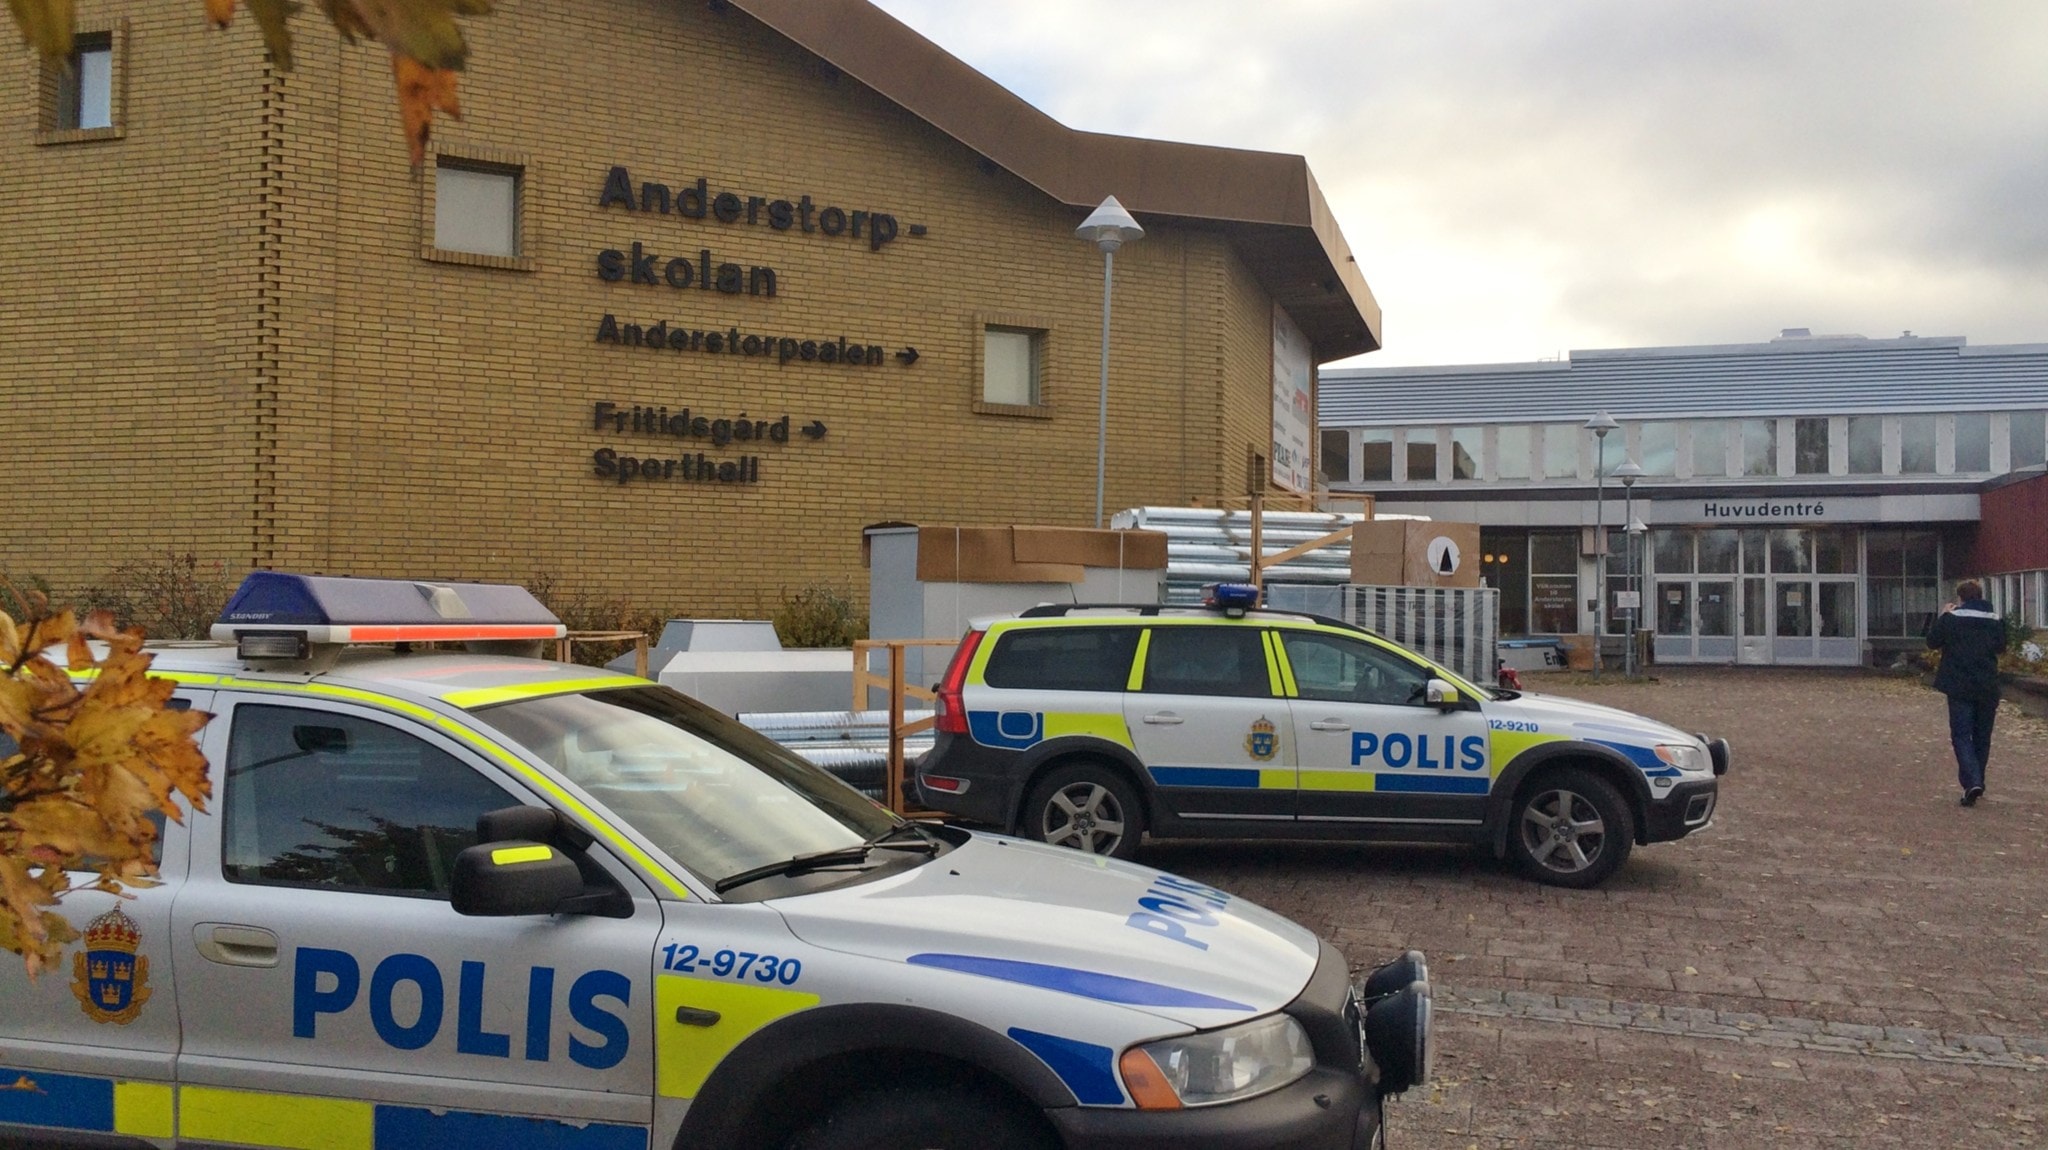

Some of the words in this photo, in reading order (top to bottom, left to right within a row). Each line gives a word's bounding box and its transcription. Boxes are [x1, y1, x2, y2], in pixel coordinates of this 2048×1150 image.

[597, 241, 777, 297] skolan
[595, 313, 885, 368] Anderstorpsalen
[593, 402, 790, 447] Fritidsgård
[593, 447, 759, 485] Sporthall
[1704, 501, 1824, 517] Huvudentré
[230, 612, 273, 620] STANDBY
[1488, 719, 1540, 733] 12-9210
[1351, 731, 1485, 771] POLIS
[1125, 875, 1232, 951] POLIS
[661, 942, 802, 986] 12-9730
[292, 946, 632, 1070] POLIS
